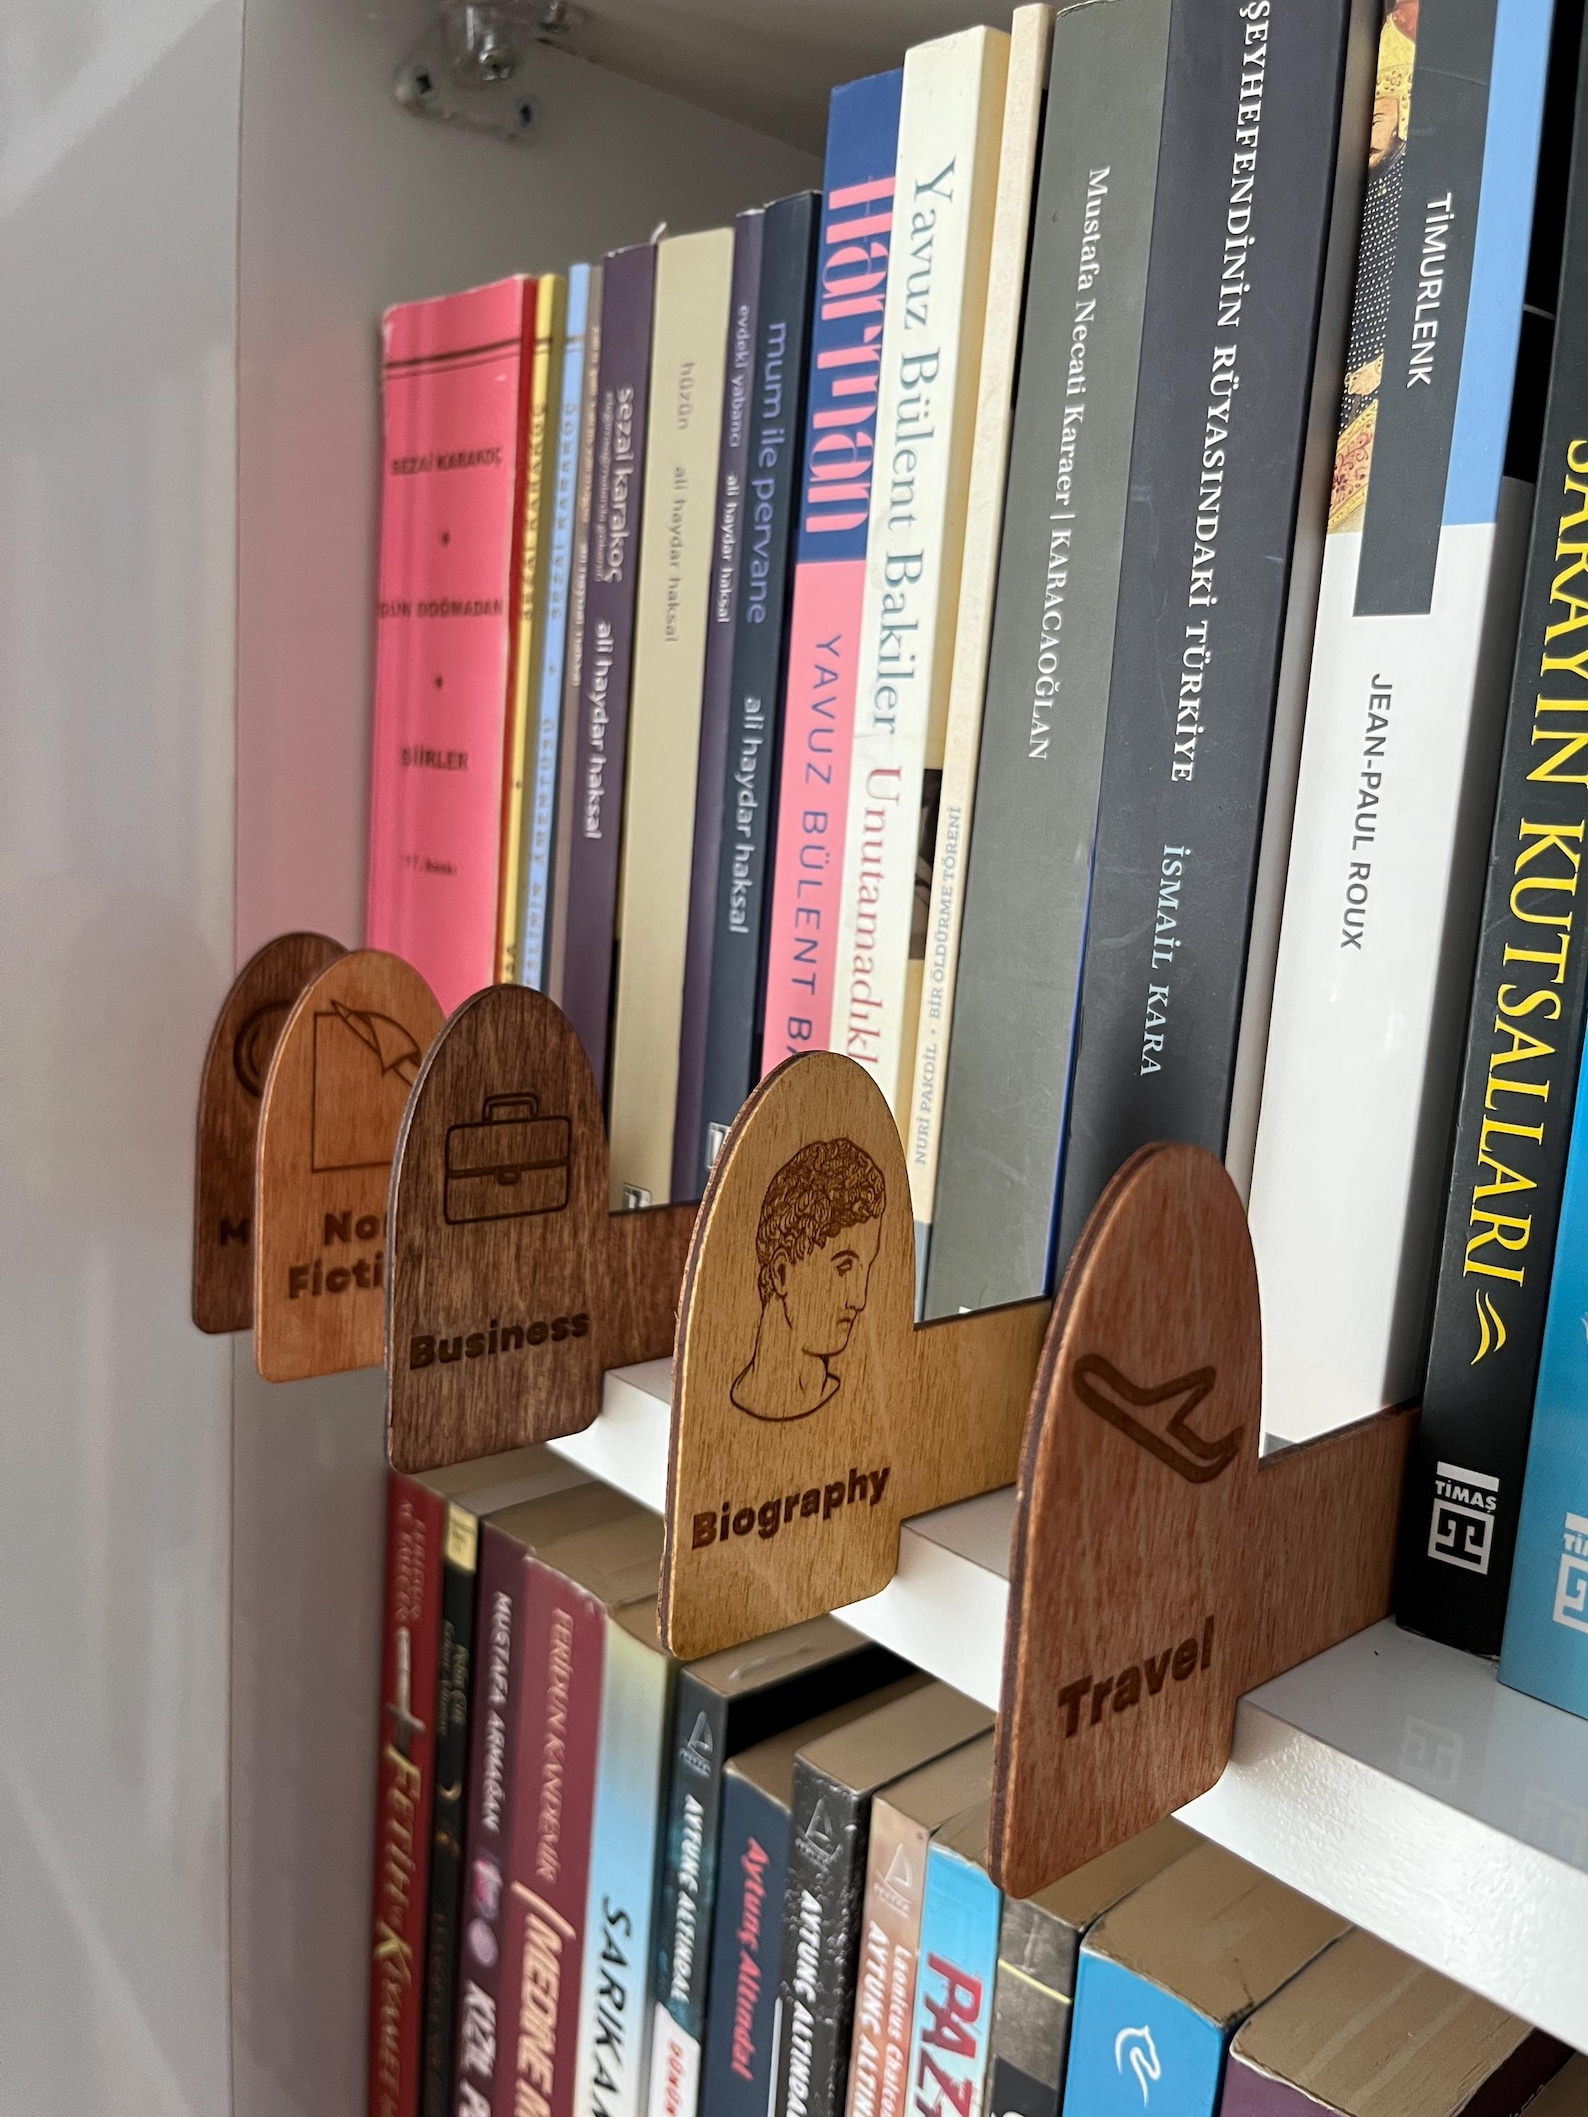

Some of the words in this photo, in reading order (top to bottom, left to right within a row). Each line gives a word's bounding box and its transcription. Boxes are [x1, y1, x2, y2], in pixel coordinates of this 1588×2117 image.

[1216, 0, 1271, 328] ŞEYHEFENDİNİN
[904, 156, 956, 331] Yavuz
[1075, 166, 1112, 293] Mustafa
[1406, 192, 1454, 388] TİMURLENK
[678, 362, 697, 430] hüzün
[763, 322, 787, 418] mum
[805, 176, 896, 534] Harman
[1066, 300, 1095, 396] Necati
[613, 386, 635, 462] sezai
[758, 428, 785, 468] ile
[888, 347, 941, 532] Bülent
[1054, 403, 1085, 506] Karaer
[602, 465, 635, 583] karakoç
[1188, 344, 1238, 607] RÜYASINDAKİ
[747, 478, 775, 624] pervane
[594, 618, 614, 653] ali
[872, 549, 925, 735] Bakiler
[1028, 526, 1071, 761] KARACAOĞLAN
[586, 655, 613, 751] haydar
[743, 694, 765, 731] ali
[804, 633, 843, 786] YAVUZ
[1172, 620, 1209, 783] TÜRKİYE
[585, 753, 606, 839] haksal
[734, 736, 763, 838] haydar
[1351, 673, 1393, 852] JEAN-PAUL
[729, 842, 756, 933] haksal
[943, 805, 962, 887] TÖRENİ
[791, 810, 831, 994] BÜLENT
[932, 885, 955, 983] ÖLDÜRME
[1151, 845, 1193, 970] İSMAİL
[1340, 862, 1372, 952] ROUX
[931, 984, 944, 1021] BİR
[1140, 982, 1171, 1077] KARA
[1462, 817, 1585, 1288] KUTSALLARI
[918, 1041, 939, 1114] PAKDİL
[914, 1118, 934, 1165] NURİ
[324, 1210, 388, 1247] No
[409, 1311, 591, 1370] Business
[690, 1466, 891, 1550] Biography
[1435, 1480, 1497, 1514] TİMAŞ
[489, 1590, 512, 1704] MUSTAFA
[1057, 1615, 1216, 1740] Travel
[677, 1793, 704, 1894] AYTUNÇ
[736, 1836, 770, 1952] Aytunç
[669, 1890, 697, 2004] ALTINDAL
[730, 1948, 762, 2082] Altındal
